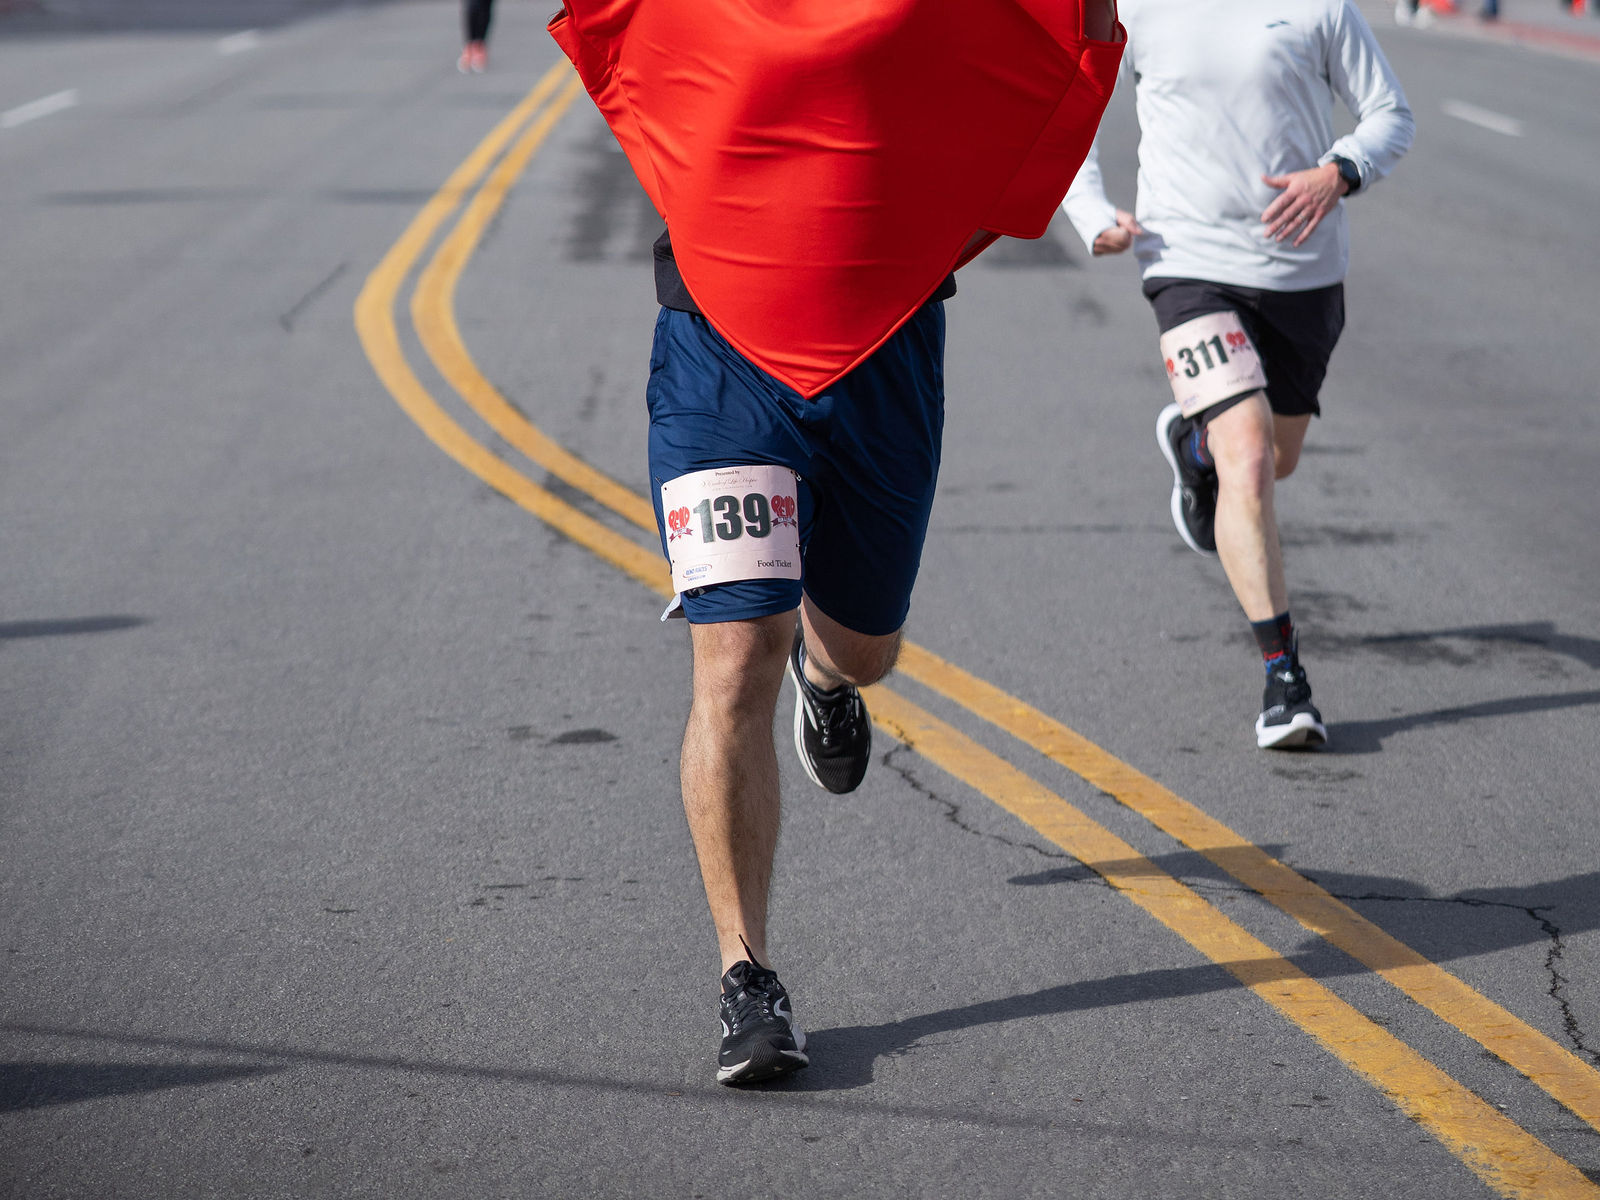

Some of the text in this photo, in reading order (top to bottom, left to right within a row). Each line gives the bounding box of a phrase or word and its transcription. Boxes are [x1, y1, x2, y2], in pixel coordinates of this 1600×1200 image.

[1178, 334, 1229, 378] 311
[668, 506, 690, 531] RENO
[693, 493, 771, 543] 139
[771, 495, 795, 518] RENO
[757, 560, 792, 568] Food Ticket
